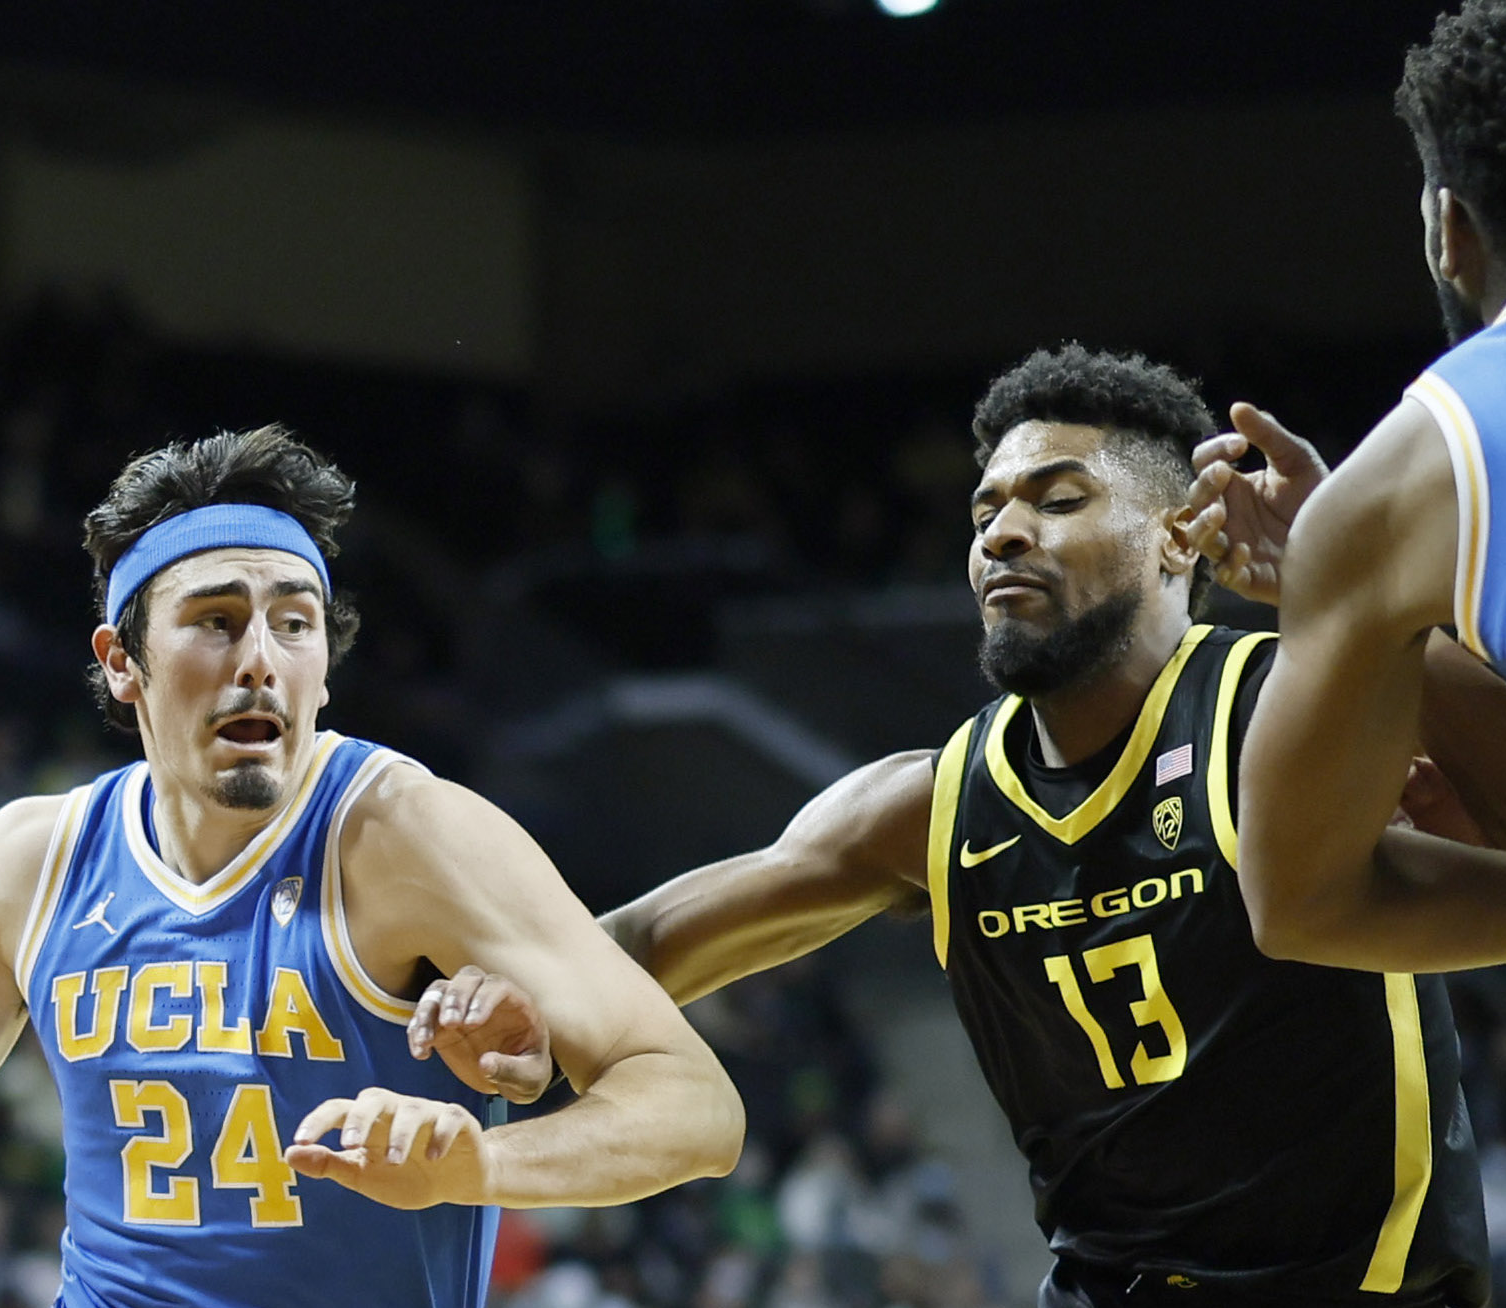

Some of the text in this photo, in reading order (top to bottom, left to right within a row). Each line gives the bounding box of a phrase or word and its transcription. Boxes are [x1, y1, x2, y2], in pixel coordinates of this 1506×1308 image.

[977, 867, 1205, 939] OREGON
[51, 961, 345, 1062] UCLA
[1043, 933, 1189, 1090] 13
[110, 1079, 303, 1228] 24
